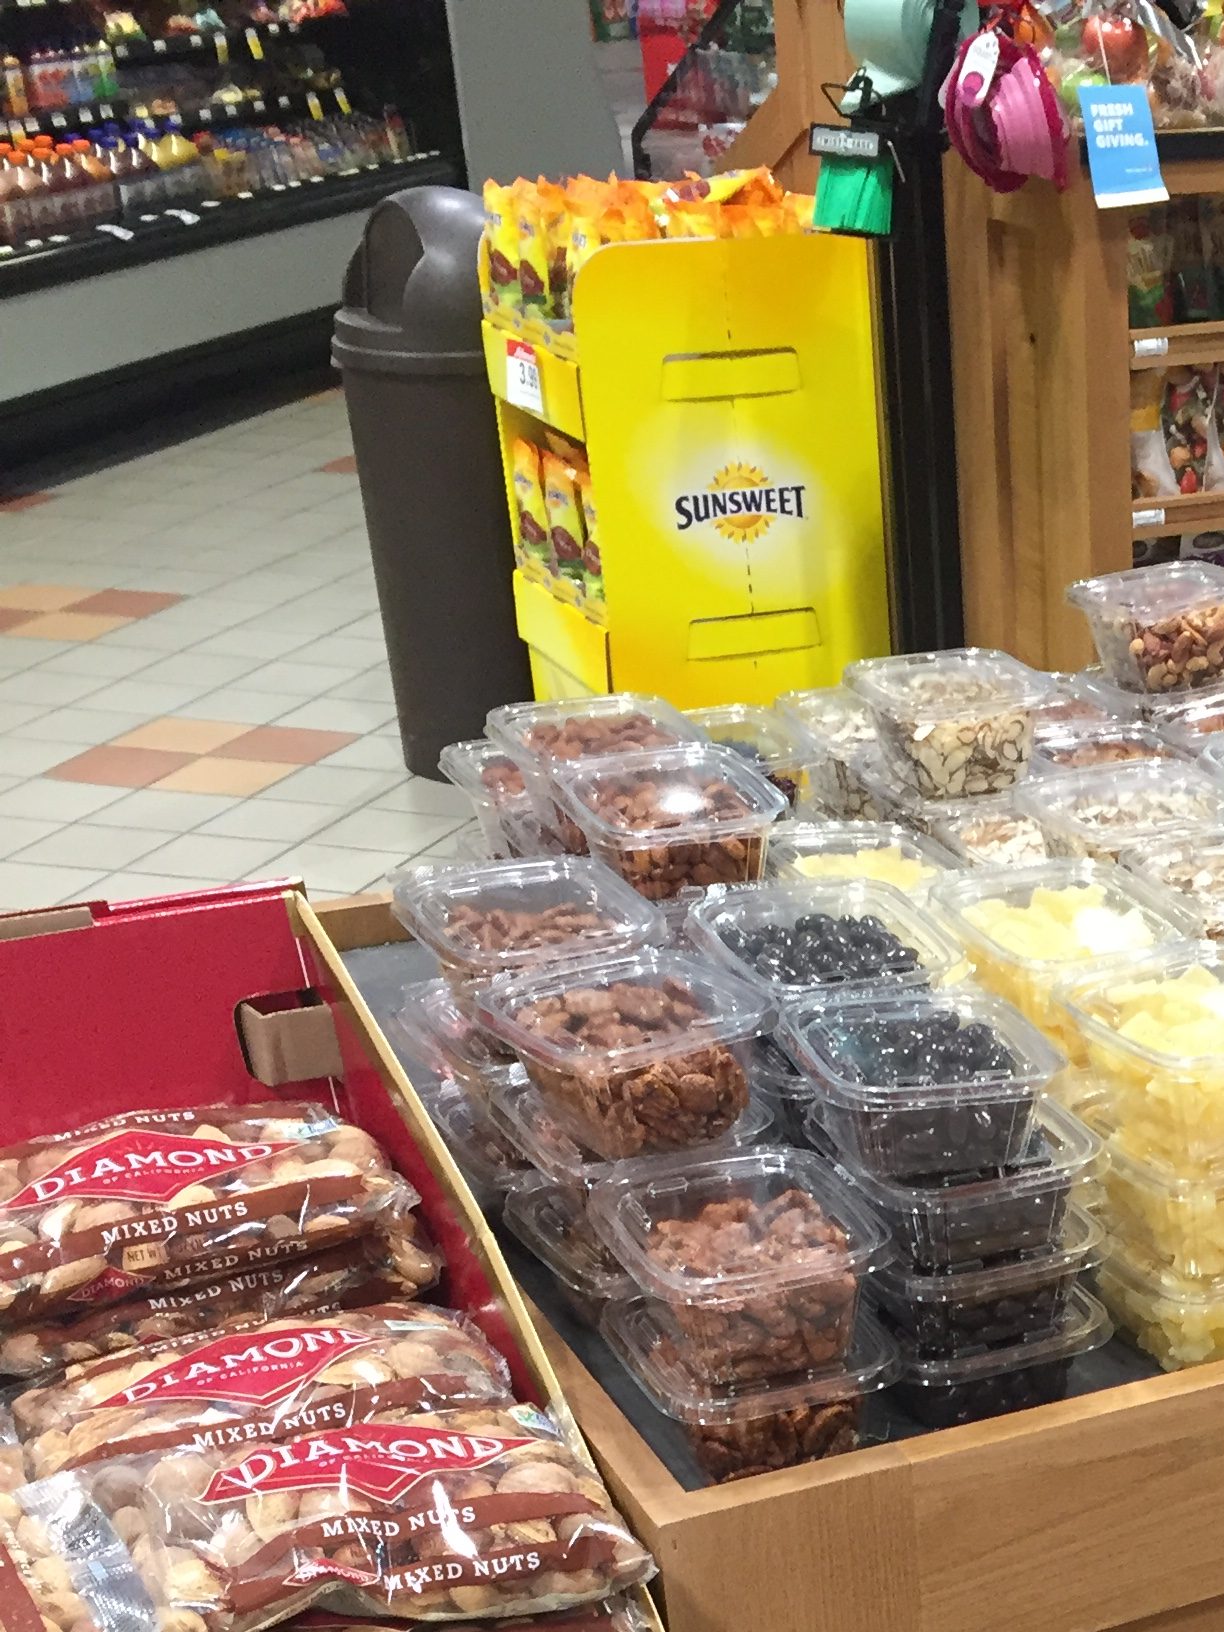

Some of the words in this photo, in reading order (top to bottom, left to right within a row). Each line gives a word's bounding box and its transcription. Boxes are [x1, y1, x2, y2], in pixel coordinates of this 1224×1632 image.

[1090, 103, 1134, 117] FRESH
[1093, 118, 1123, 132] GIFT
[1096, 132, 1149, 148] GIVING.
[675, 485, 806, 531] SUNSWEET
[134, 1111, 196, 1125] NUTS
[31, 1144, 273, 1203] DIAMOND
[101, 1215, 178, 1245] MIXED
[187, 1201, 249, 1226] NUTS
[163, 1254, 240, 1282] MIXED
[248, 1239, 309, 1261] NUTS
[148, 1283, 222, 1311] MIXED
[228, 1268, 285, 1293] NUTS
[121, 1328, 373, 1403] DIAMOND
[219, 1360, 305, 1381] CALIFORNIA
[192, 1420, 275, 1449] MIXED
[282, 1401, 347, 1430] NUTS
[236, 1435, 503, 1489] DIAMOND
[321, 1513, 400, 1539] MIXED
[383, 1563, 463, 1593] MIXED
[473, 1551, 542, 1578] NUTS
